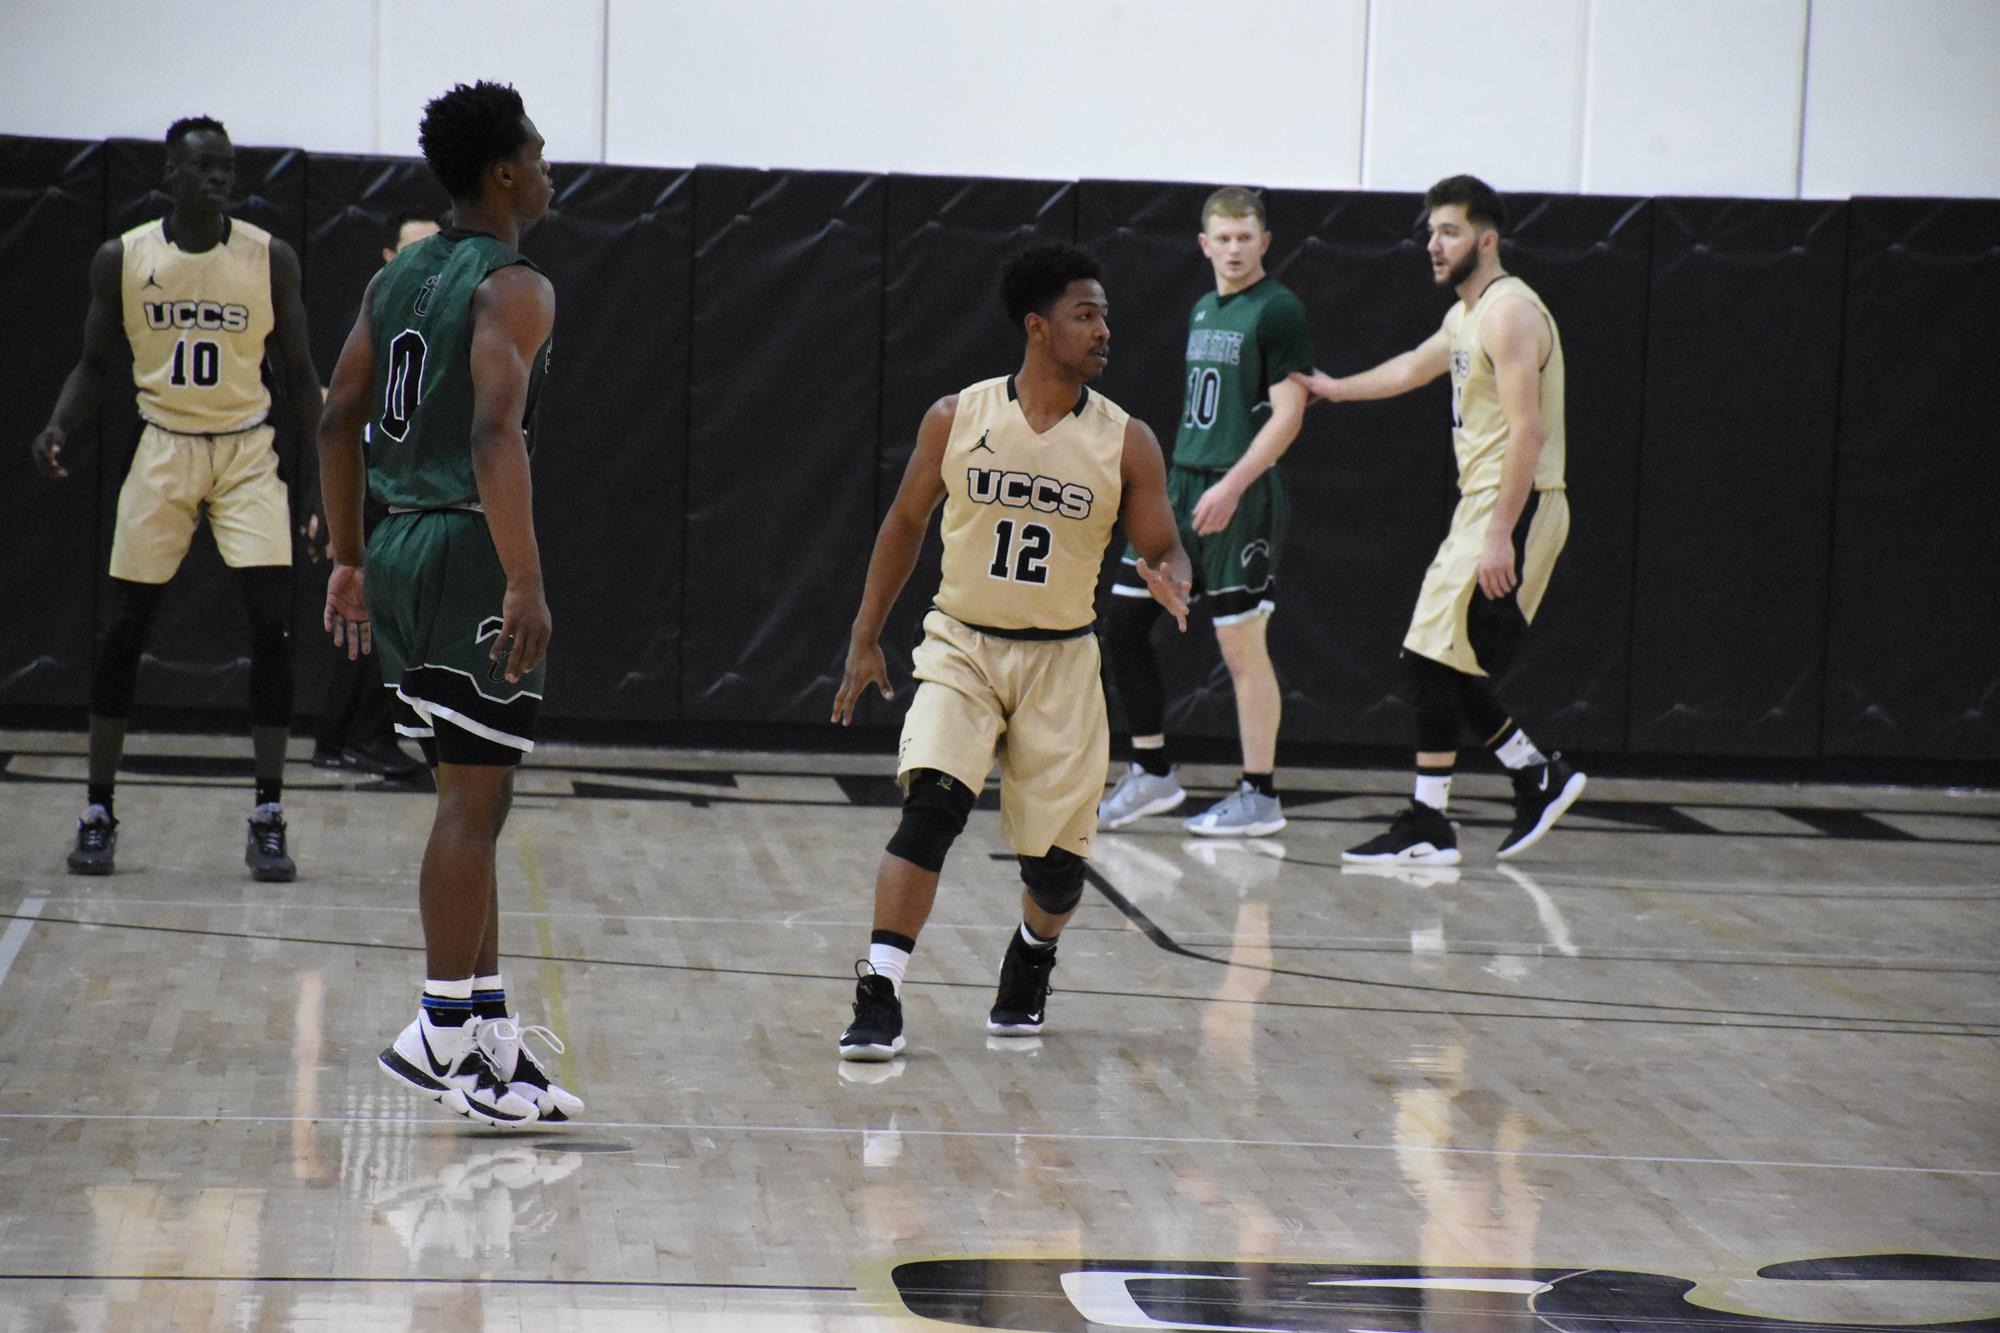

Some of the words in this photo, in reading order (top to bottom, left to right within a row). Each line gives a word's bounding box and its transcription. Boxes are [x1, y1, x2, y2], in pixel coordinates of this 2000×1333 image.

[143, 300, 249, 333] UCCS
[169, 338, 221, 389] 10
[1183, 366, 1221, 430] 10
[967, 467, 1094, 520] UCCS
[988, 518, 1052, 586] 12
